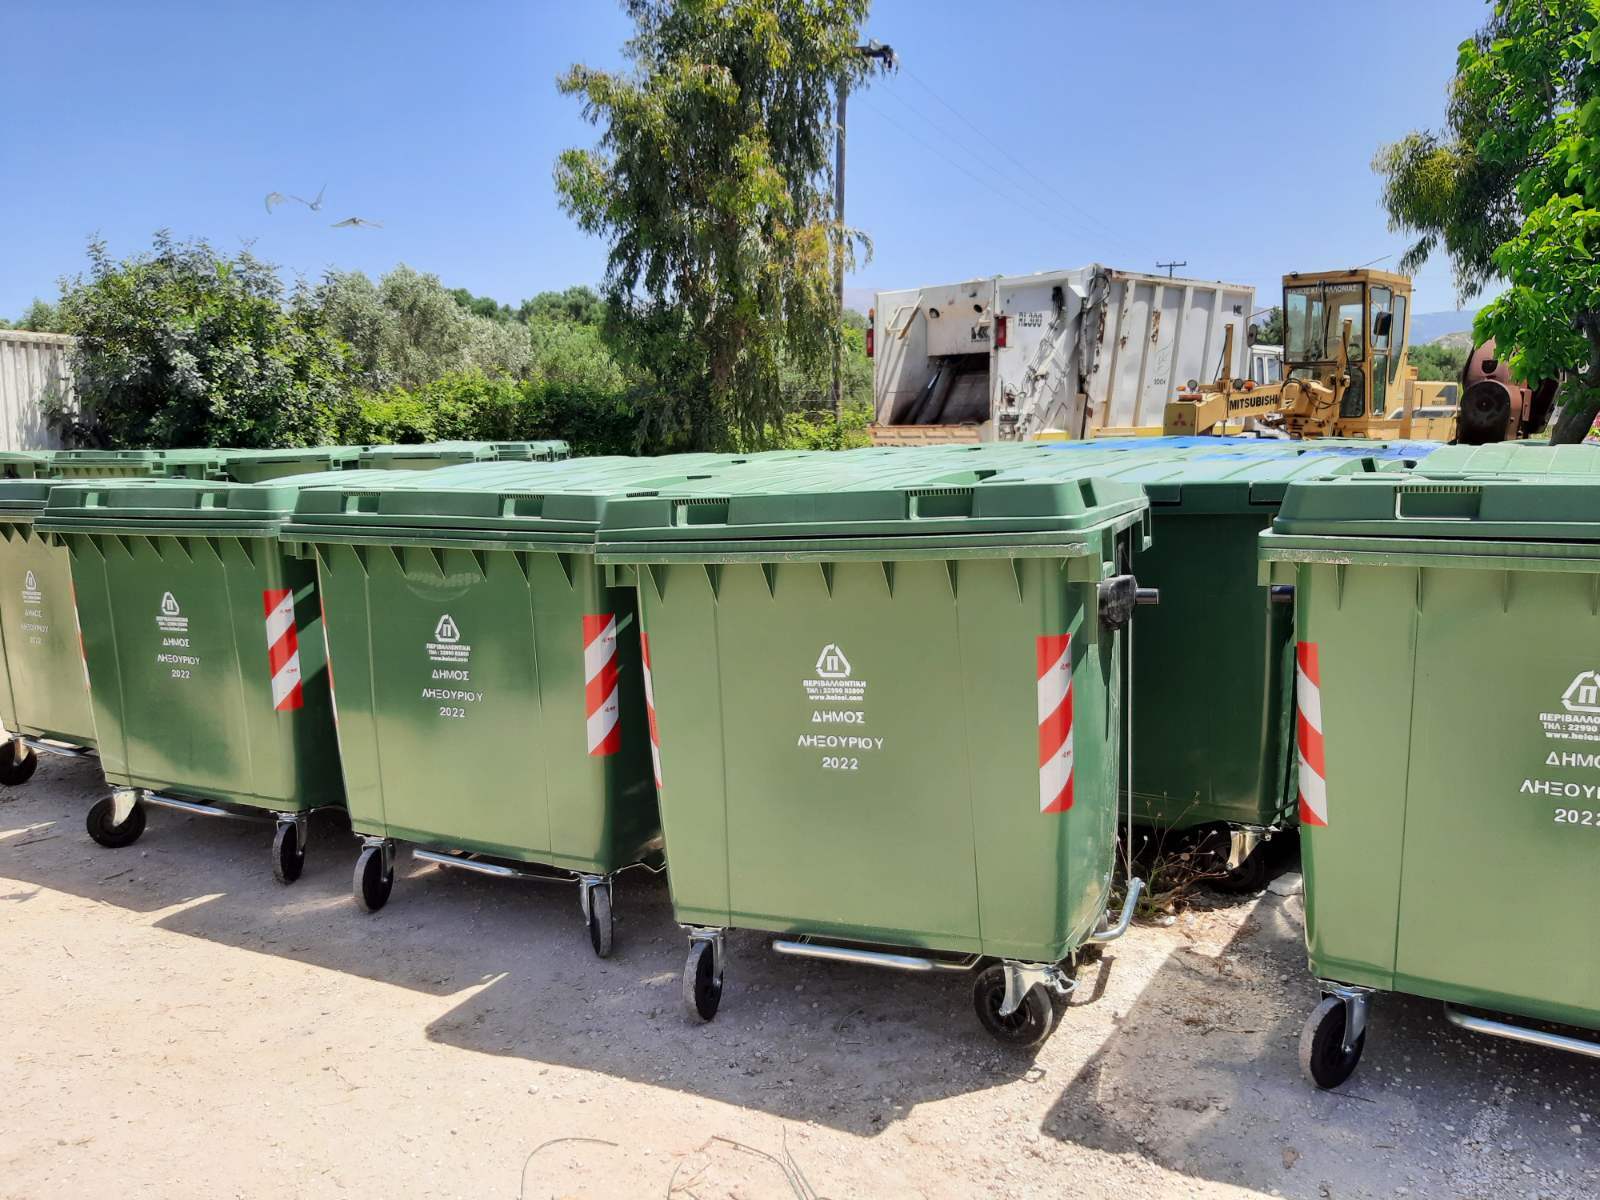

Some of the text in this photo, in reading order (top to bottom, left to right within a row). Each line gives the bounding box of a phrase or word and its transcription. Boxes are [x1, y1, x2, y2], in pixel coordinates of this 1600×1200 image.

[1018, 312, 1042, 327] RL300
[1229, 394, 1278, 410] MITSUBISHI
[163, 638, 190, 648] ΔΗΜΟΣ
[157, 653, 200, 665] ΛΗΞΟΥΡΙΟΥ
[171, 669, 191, 679] 2022
[432, 669, 470, 681] ΔΗΜΟΣ
[803, 680, 867, 688] ΠΕΡΙΒΑΛΛΟΝΤΙΚΗ
[422, 688, 484, 702] ΛΗΞΟΥΡΙΟΥ
[440, 706, 465, 718] 2022
[811, 711, 865, 724] ΔΗΜΟΣ
[1567, 724, 1598, 732] 22990
[797, 734, 884, 749] ΛΗΞΟΥΡΙΟΥ
[822, 757, 858, 770] 2022
[1519, 779, 1600, 799] ΛΗΞΟΥ
